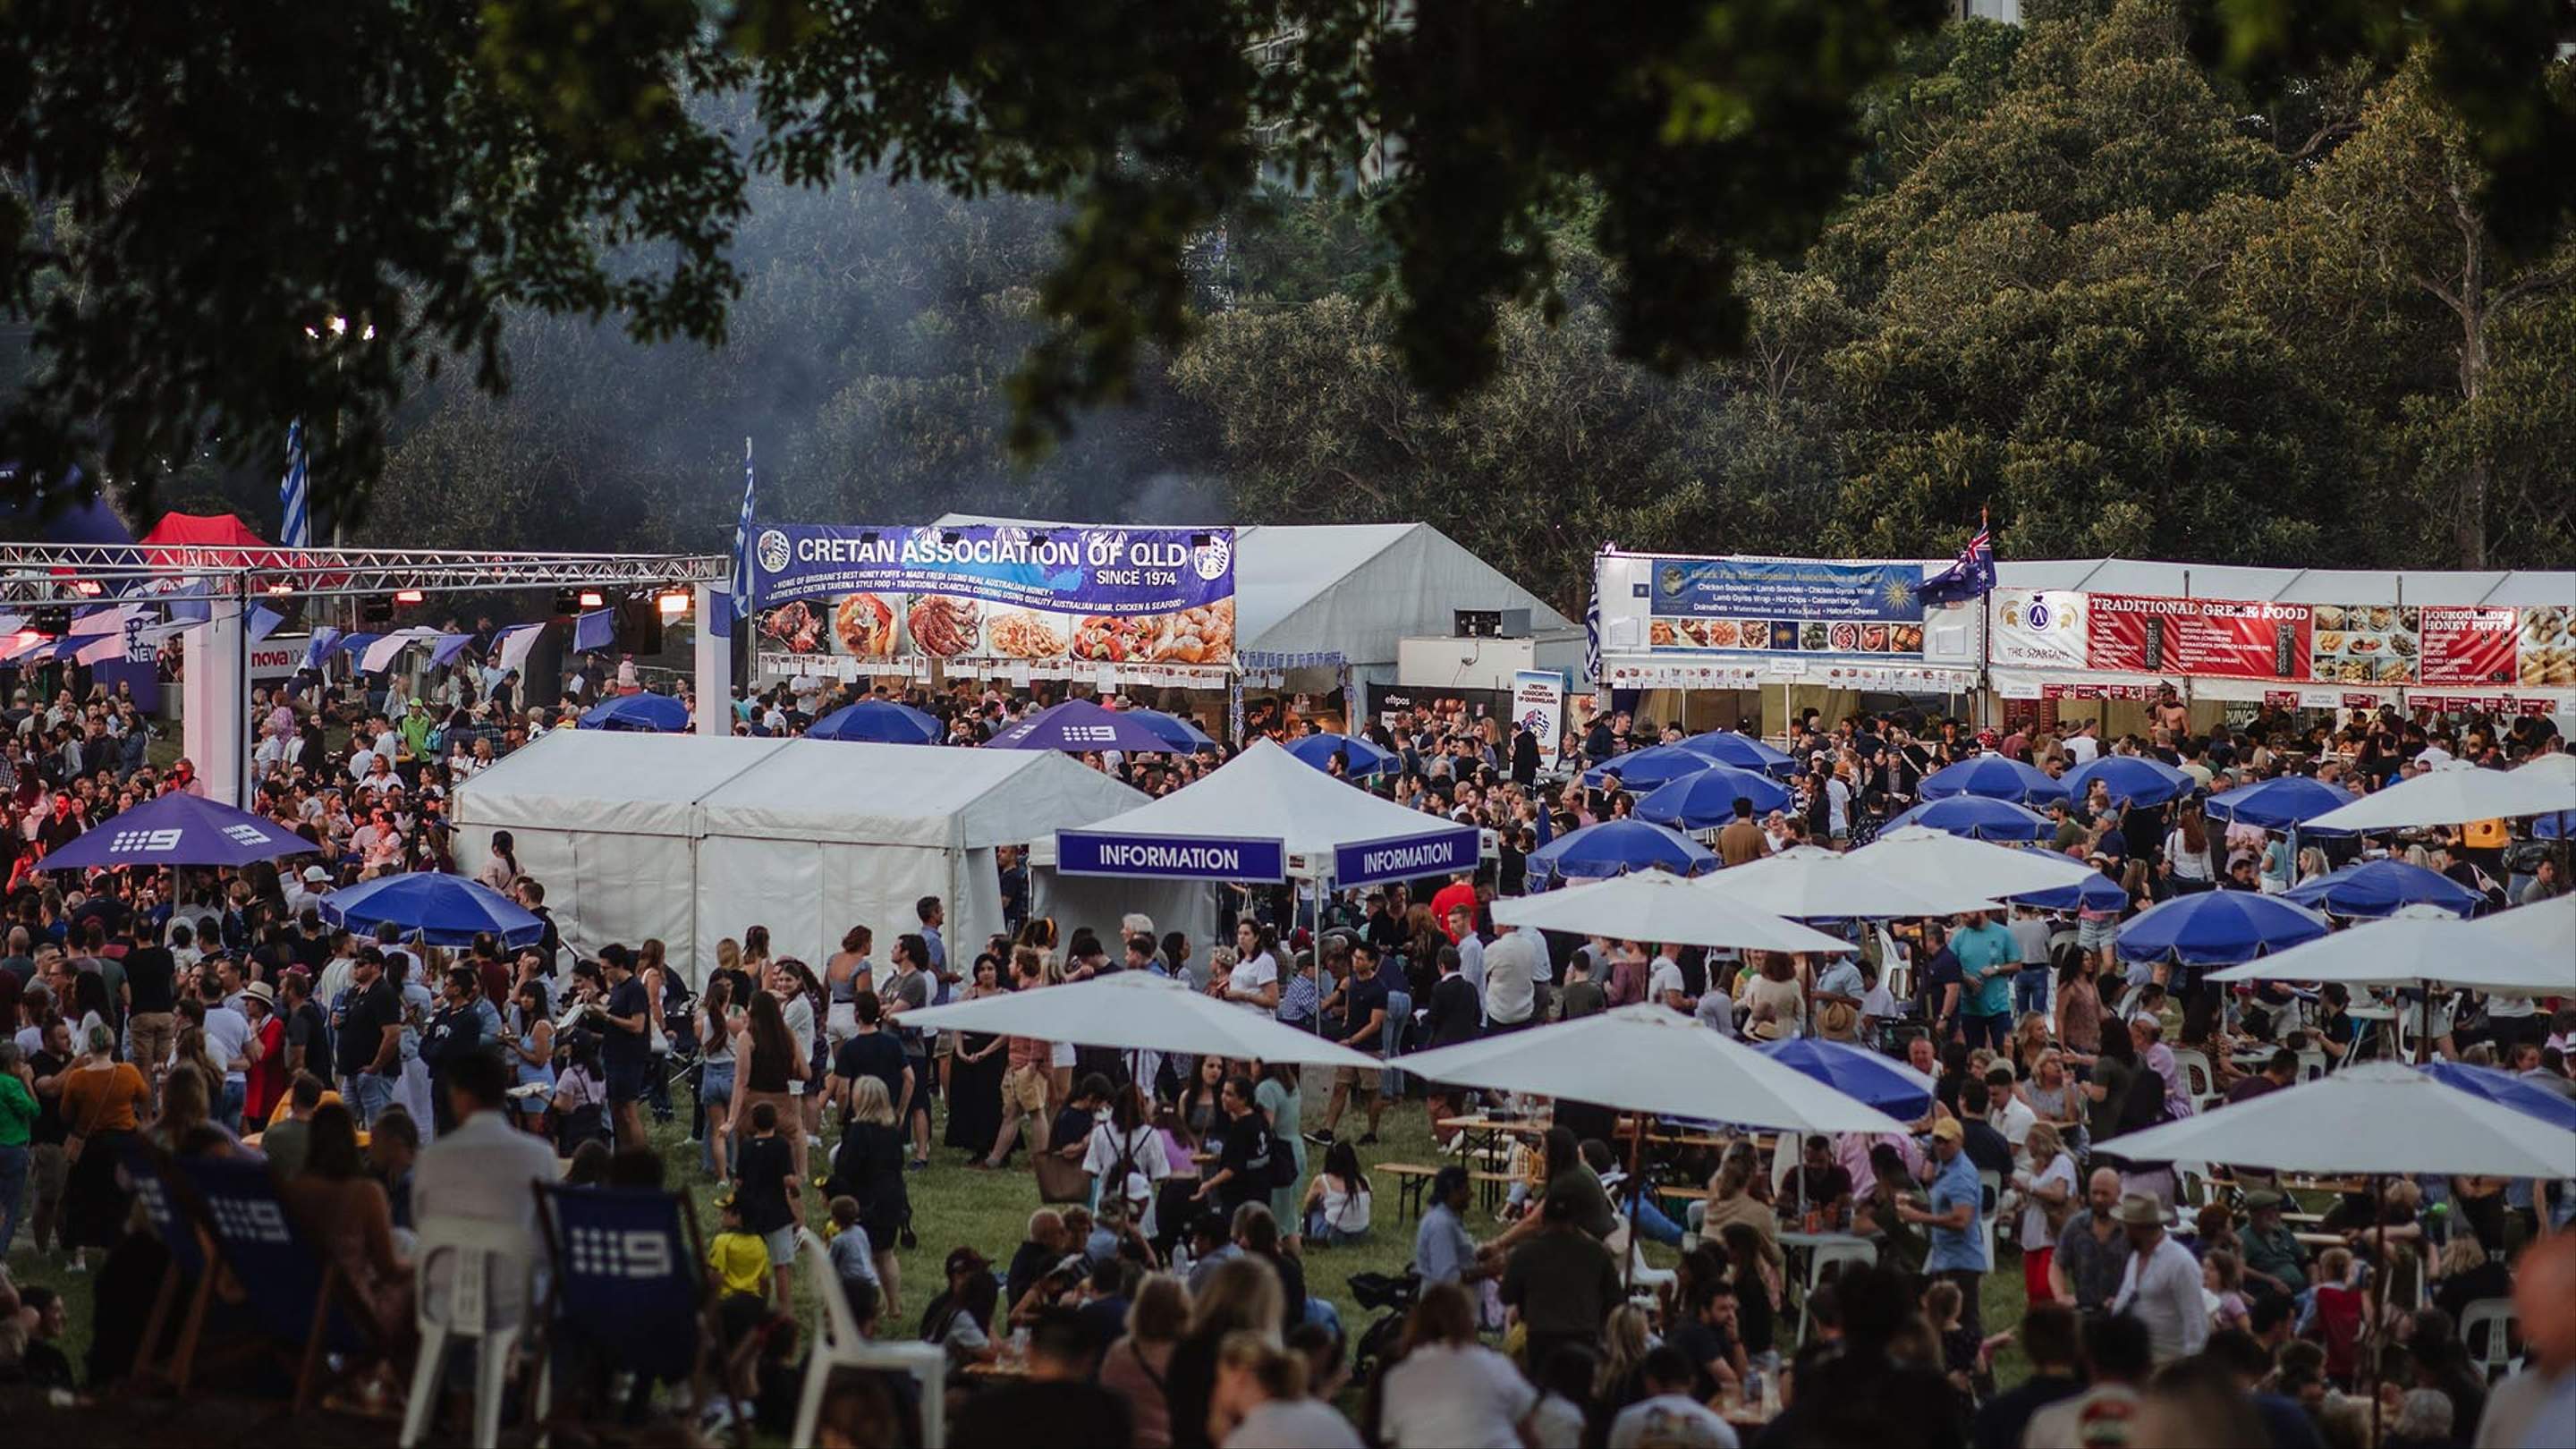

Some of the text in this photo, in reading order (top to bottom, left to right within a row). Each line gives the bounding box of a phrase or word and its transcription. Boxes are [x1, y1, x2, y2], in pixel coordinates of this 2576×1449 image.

[798, 538, 1187, 567] CRETAN ASSOCIATION OF QLD
[777, 570, 1049, 597] HOME OF BRISBANE'S BEST HONEY PUFFS MADE FRESH USING REAL AUSTRALIAN HONEY
[1096, 571, 1177, 586] SINCE 1974
[770, 587, 802, 600] AUTHENTIC
[803, 583, 826, 594] CRETAN
[827, 581, 855, 592] TAVERNA
[856, 580, 873, 589] STYLE
[874, 580, 891, 589] FOOD
[896, 580, 938, 590] TRADITIONAL
[938, 582, 972, 594] CHARCOAL
[973, 585, 1003, 597] COOKING
[1003, 590, 1024, 602] USING
[1024, 595, 1053, 606] QUALITY
[1052, 599, 1094, 610] AUSTRALIAN
[1115, 603, 1144, 612] CHICKEN
[1151, 598, 1182, 611] SEAFOOD
[1698, 583, 1876, 597] Chicken Souvlaki Lamb Souvlaki Chicken Gyros Wrap
[1712, 594, 1860, 606] Lamb Gyros Wrap Hot Chips Calamari Rings
[1853, 607, 1879, 616] Cheese
[2092, 597, 2309, 621] TRADITIONAL GREEK FOOD
[2425, 620, 2512, 631] HONEY PUFFS
[251, 651, 288, 667] nova
[1385, 694, 1411, 708] eftpos
[1522, 690, 1554, 698] ASSOCIATION
[1525, 696, 1557, 705] QUEENSLAND
[1099, 843, 1239, 871] INFORMATION
[1362, 841, 1453, 875] INFORMATION
